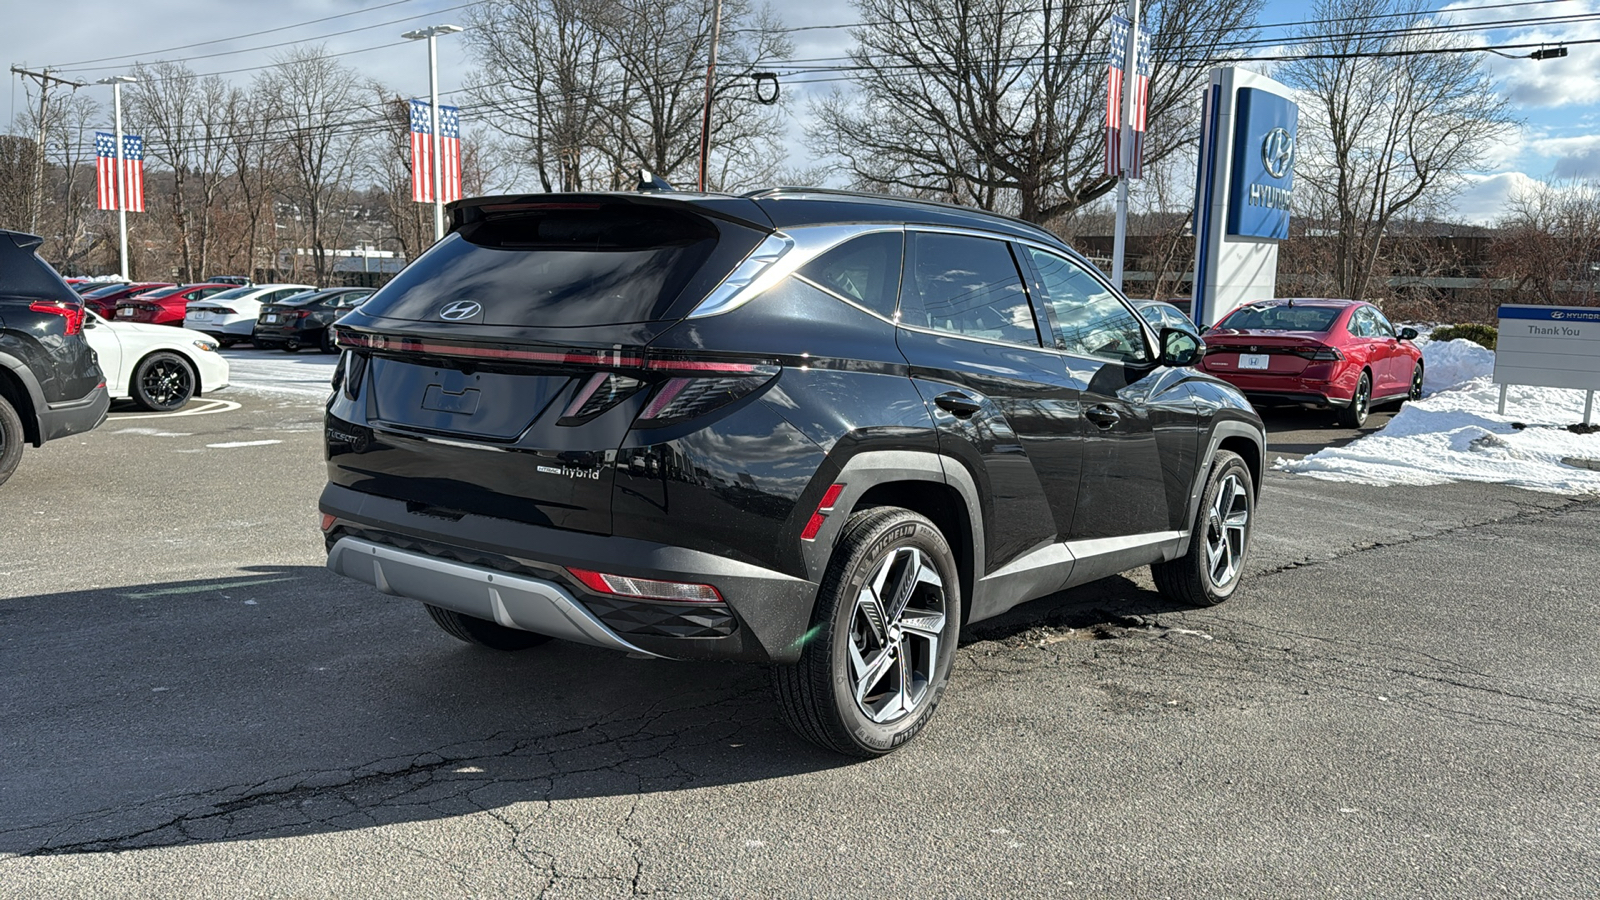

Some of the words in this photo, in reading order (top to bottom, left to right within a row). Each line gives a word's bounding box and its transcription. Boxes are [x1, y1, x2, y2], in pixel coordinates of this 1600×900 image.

[1249, 183, 1291, 211] HYUNDA
[1566, 312, 1600, 320] HYUNDA
[1528, 325, 1559, 335] Thank
[1562, 327, 1580, 336] You
[328, 428, 357, 443] TUCSON
[562, 465, 600, 480] hybrid
[871, 526, 915, 558] MICHELIN
